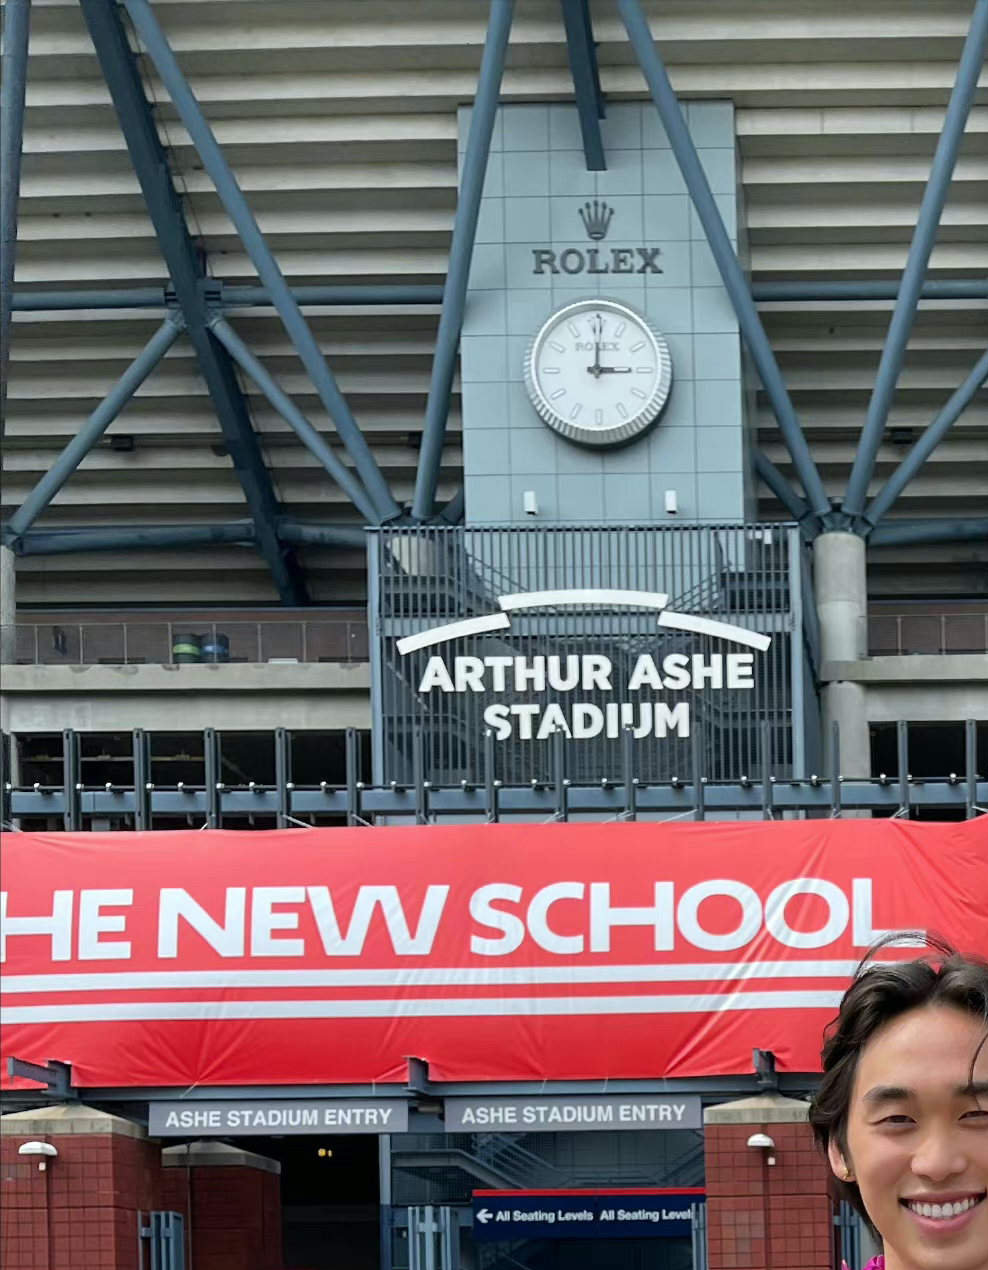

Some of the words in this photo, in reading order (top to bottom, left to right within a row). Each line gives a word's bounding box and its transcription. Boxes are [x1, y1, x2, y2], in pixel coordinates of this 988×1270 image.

[532, 248, 664, 274] ROLEX
[418, 653, 613, 692] ARTHUR
[628, 653, 755, 690] ASHE
[483, 702, 690, 741] STADIUM
[157, 884, 449, 959] NEW
[469, 877, 928, 955] SCHOOL
[166, 1110, 221, 1128] ASHE
[227, 1109, 318, 1127] STADIUM
[324, 1108, 392, 1126] ENTRY
[462, 1106, 517, 1124] ASHE
[522, 1105, 613, 1123] STADIUM
[619, 1104, 686, 1122] ENTRY
[495, 1210, 510, 1222] All
[513, 1210, 555, 1224] Seating
[558, 1209, 594, 1221] Levels
[600, 1209, 615, 1221] All
[617, 1209, 659, 1223] Seating
